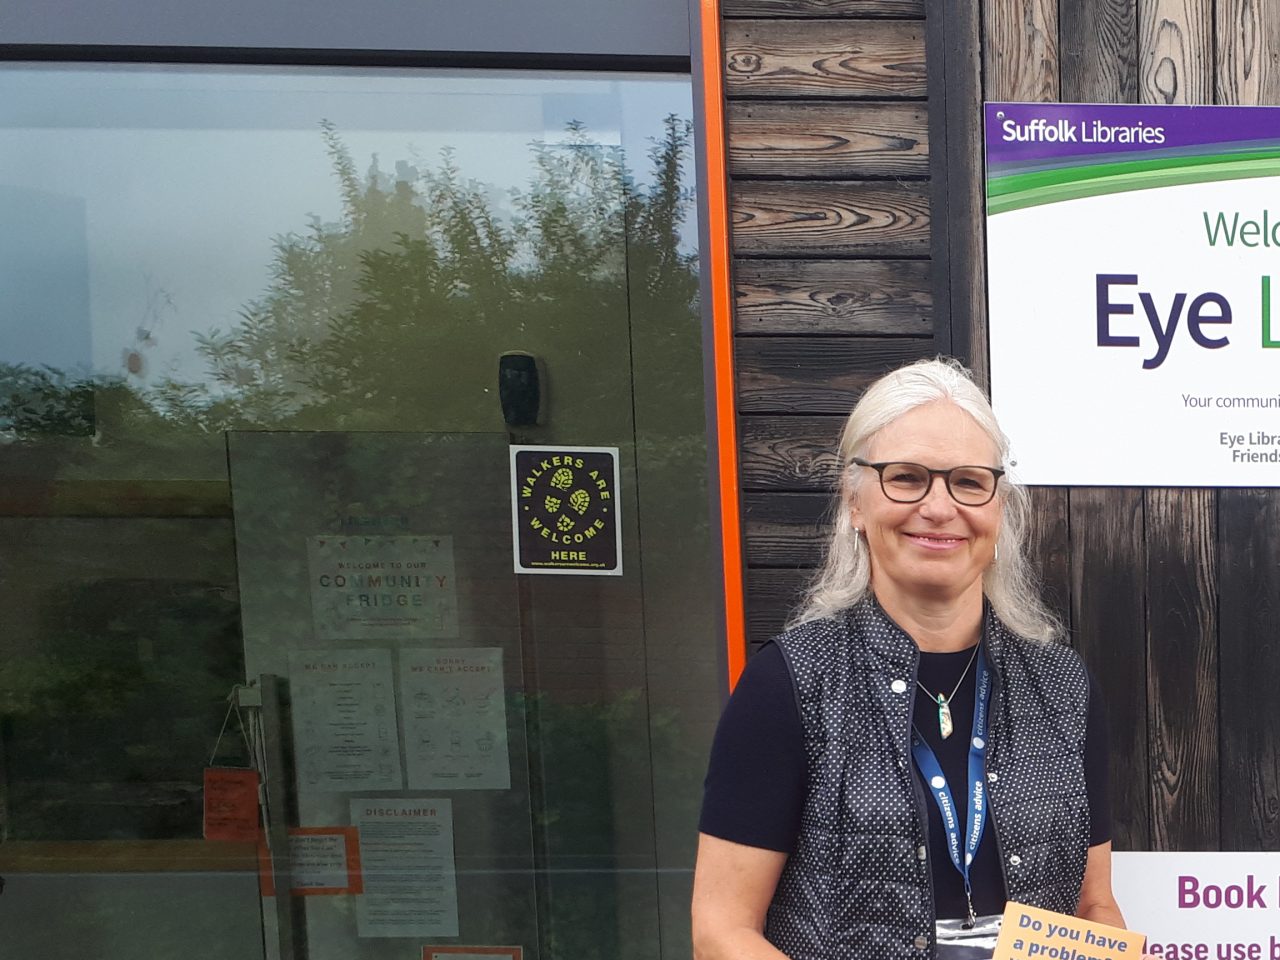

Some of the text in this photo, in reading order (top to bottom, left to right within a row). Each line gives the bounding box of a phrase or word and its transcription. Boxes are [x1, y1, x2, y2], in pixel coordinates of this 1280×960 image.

[1002, 119, 1165, 144] Suffolk Libraries
[1095, 272, 1233, 370] Eye
[1181, 394, 1213, 408] Your
[1220, 432, 1244, 448] Eye
[522, 456, 610, 500] WALKERS ARE
[530, 517, 605, 544] WELCOME
[551, 551, 587, 560] HERE
[319, 575, 446, 588] COMMUNITY
[346, 594, 422, 607] FRIDGE
[977, 670, 990, 736] citizens advice
[365, 808, 437, 817] DISCLAIMER
[969, 780, 984, 850] citizens advice
[938, 791, 961, 865] citizens advice
[1178, 875, 1267, 909] Book
[1012, 937, 1024, 951] a
[1018, 914, 1128, 952] Do you have
[1142, 936, 1208, 960] lease
[1216, 942, 1261, 960] use
